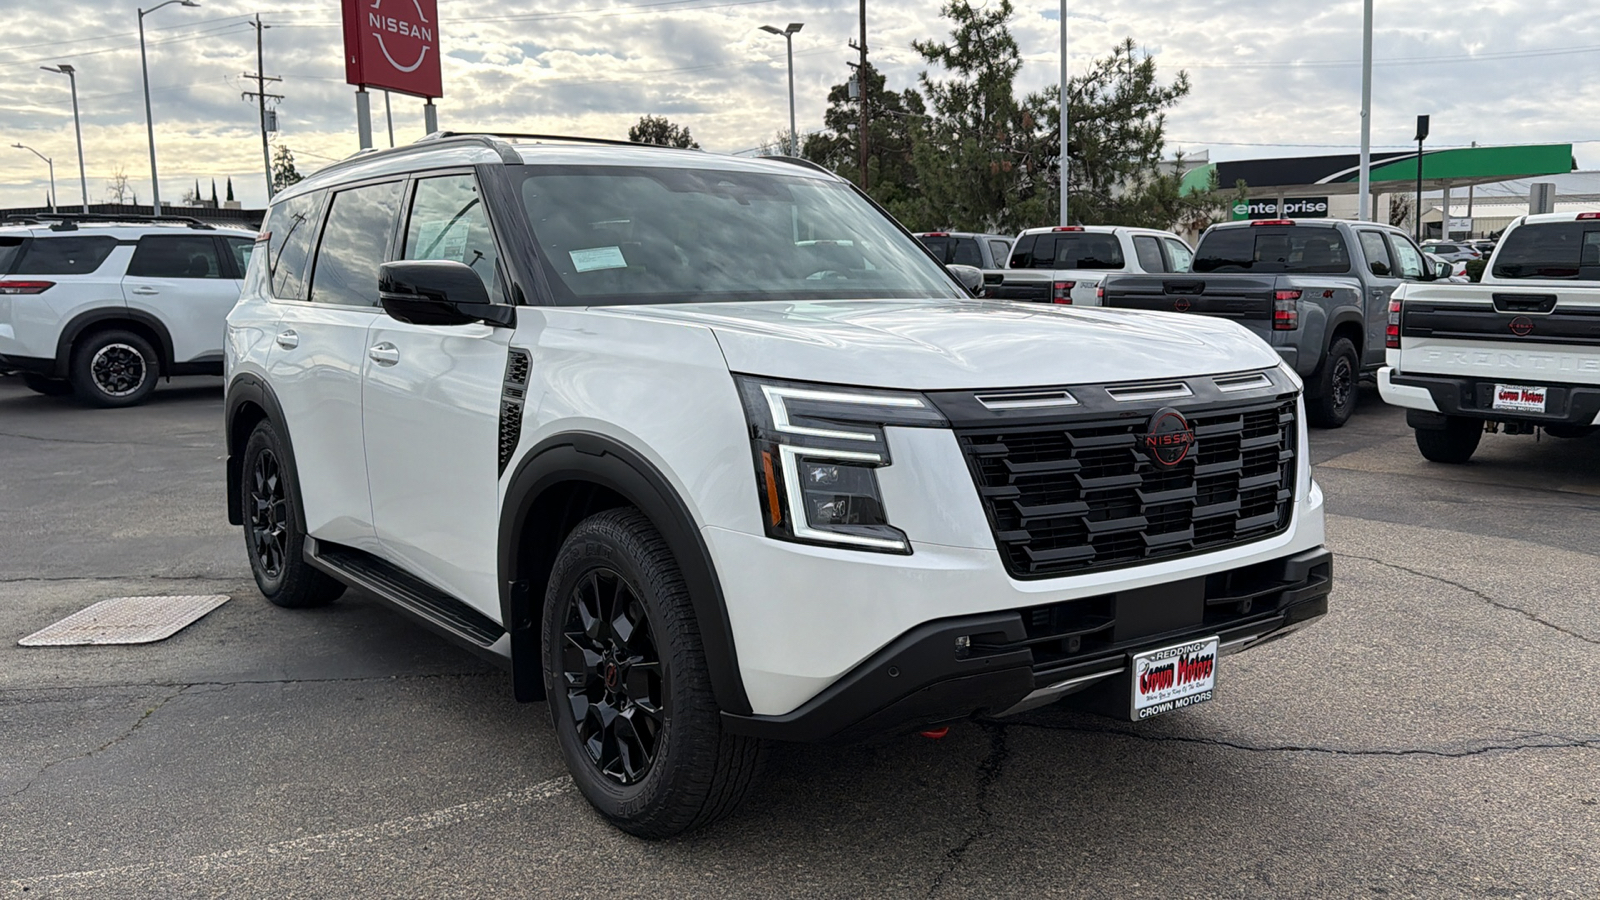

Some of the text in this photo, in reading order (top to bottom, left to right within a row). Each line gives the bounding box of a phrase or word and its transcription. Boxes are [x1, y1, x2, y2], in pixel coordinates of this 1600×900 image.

[369, 12, 432, 42] NISSAN
[1422, 350, 1600, 372] FRONTIE
[1146, 432, 1194, 446] NISSAN
[1156, 643, 1201, 661] REDDING
[1140, 653, 1214, 695] Crown Motors
[1139, 691, 1212, 718] CROWN MOTORS
